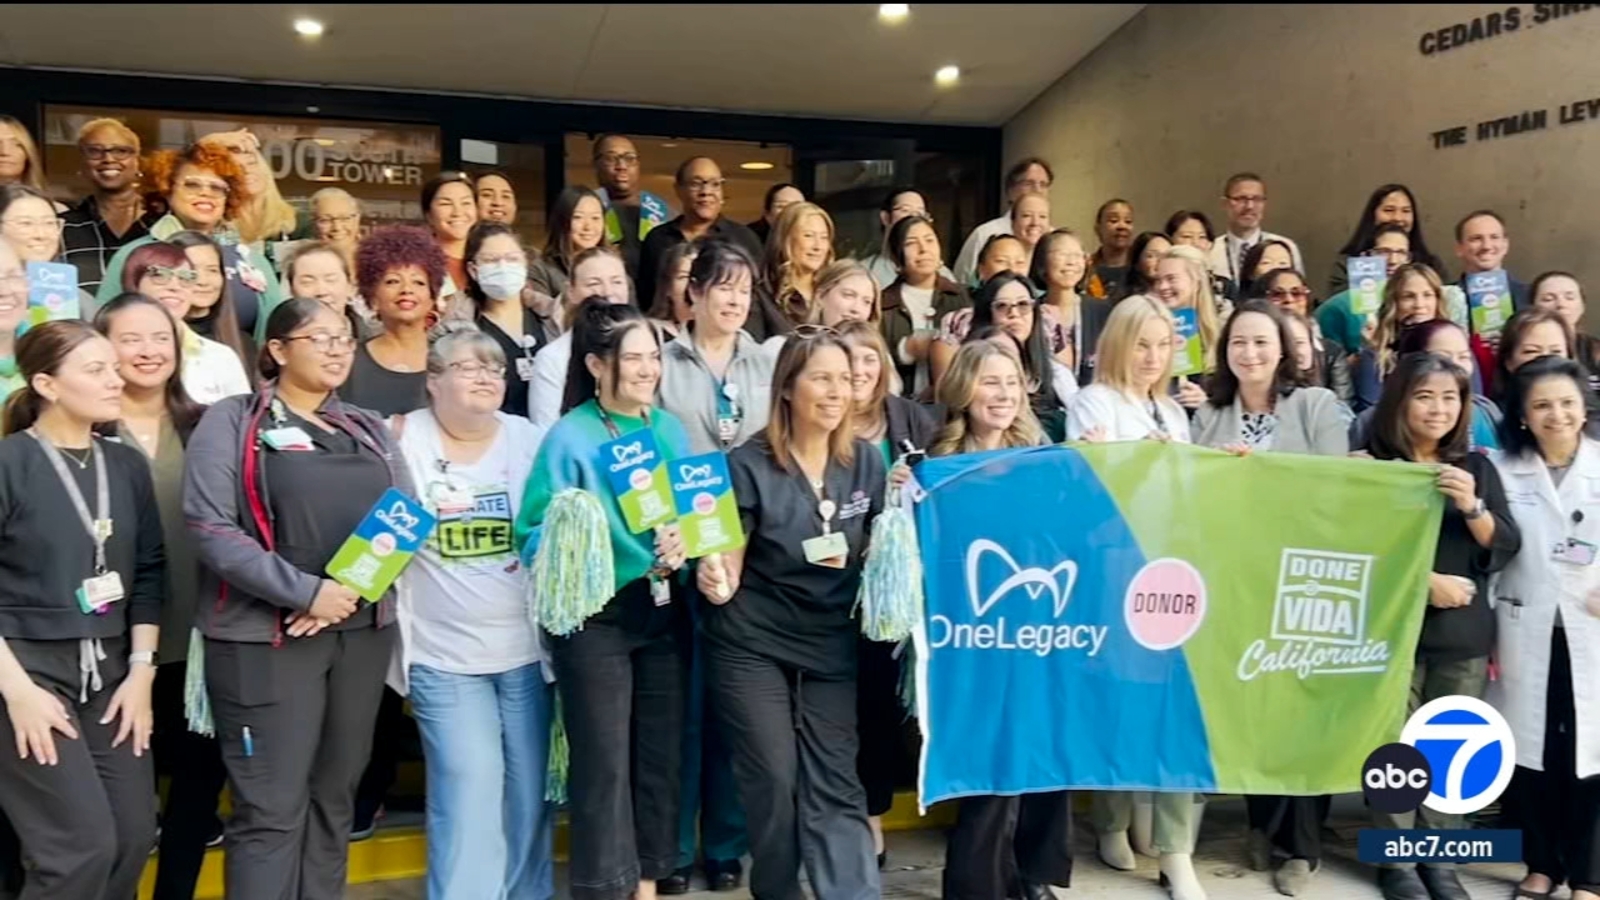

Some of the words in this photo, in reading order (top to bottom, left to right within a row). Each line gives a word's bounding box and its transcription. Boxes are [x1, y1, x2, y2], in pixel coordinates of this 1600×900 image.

[1419, 7, 1520, 55] CEDARS
[1431, 126, 1467, 149] THE
[1477, 110, 1547, 141] HYMAN
[328, 162, 422, 185] TOWER
[445, 526, 507, 551] LIFE
[1290, 557, 1361, 582] DONE
[1133, 592, 1196, 615] DONOR
[1283, 596, 1354, 636] VIDA
[1236, 638, 1390, 681] California
